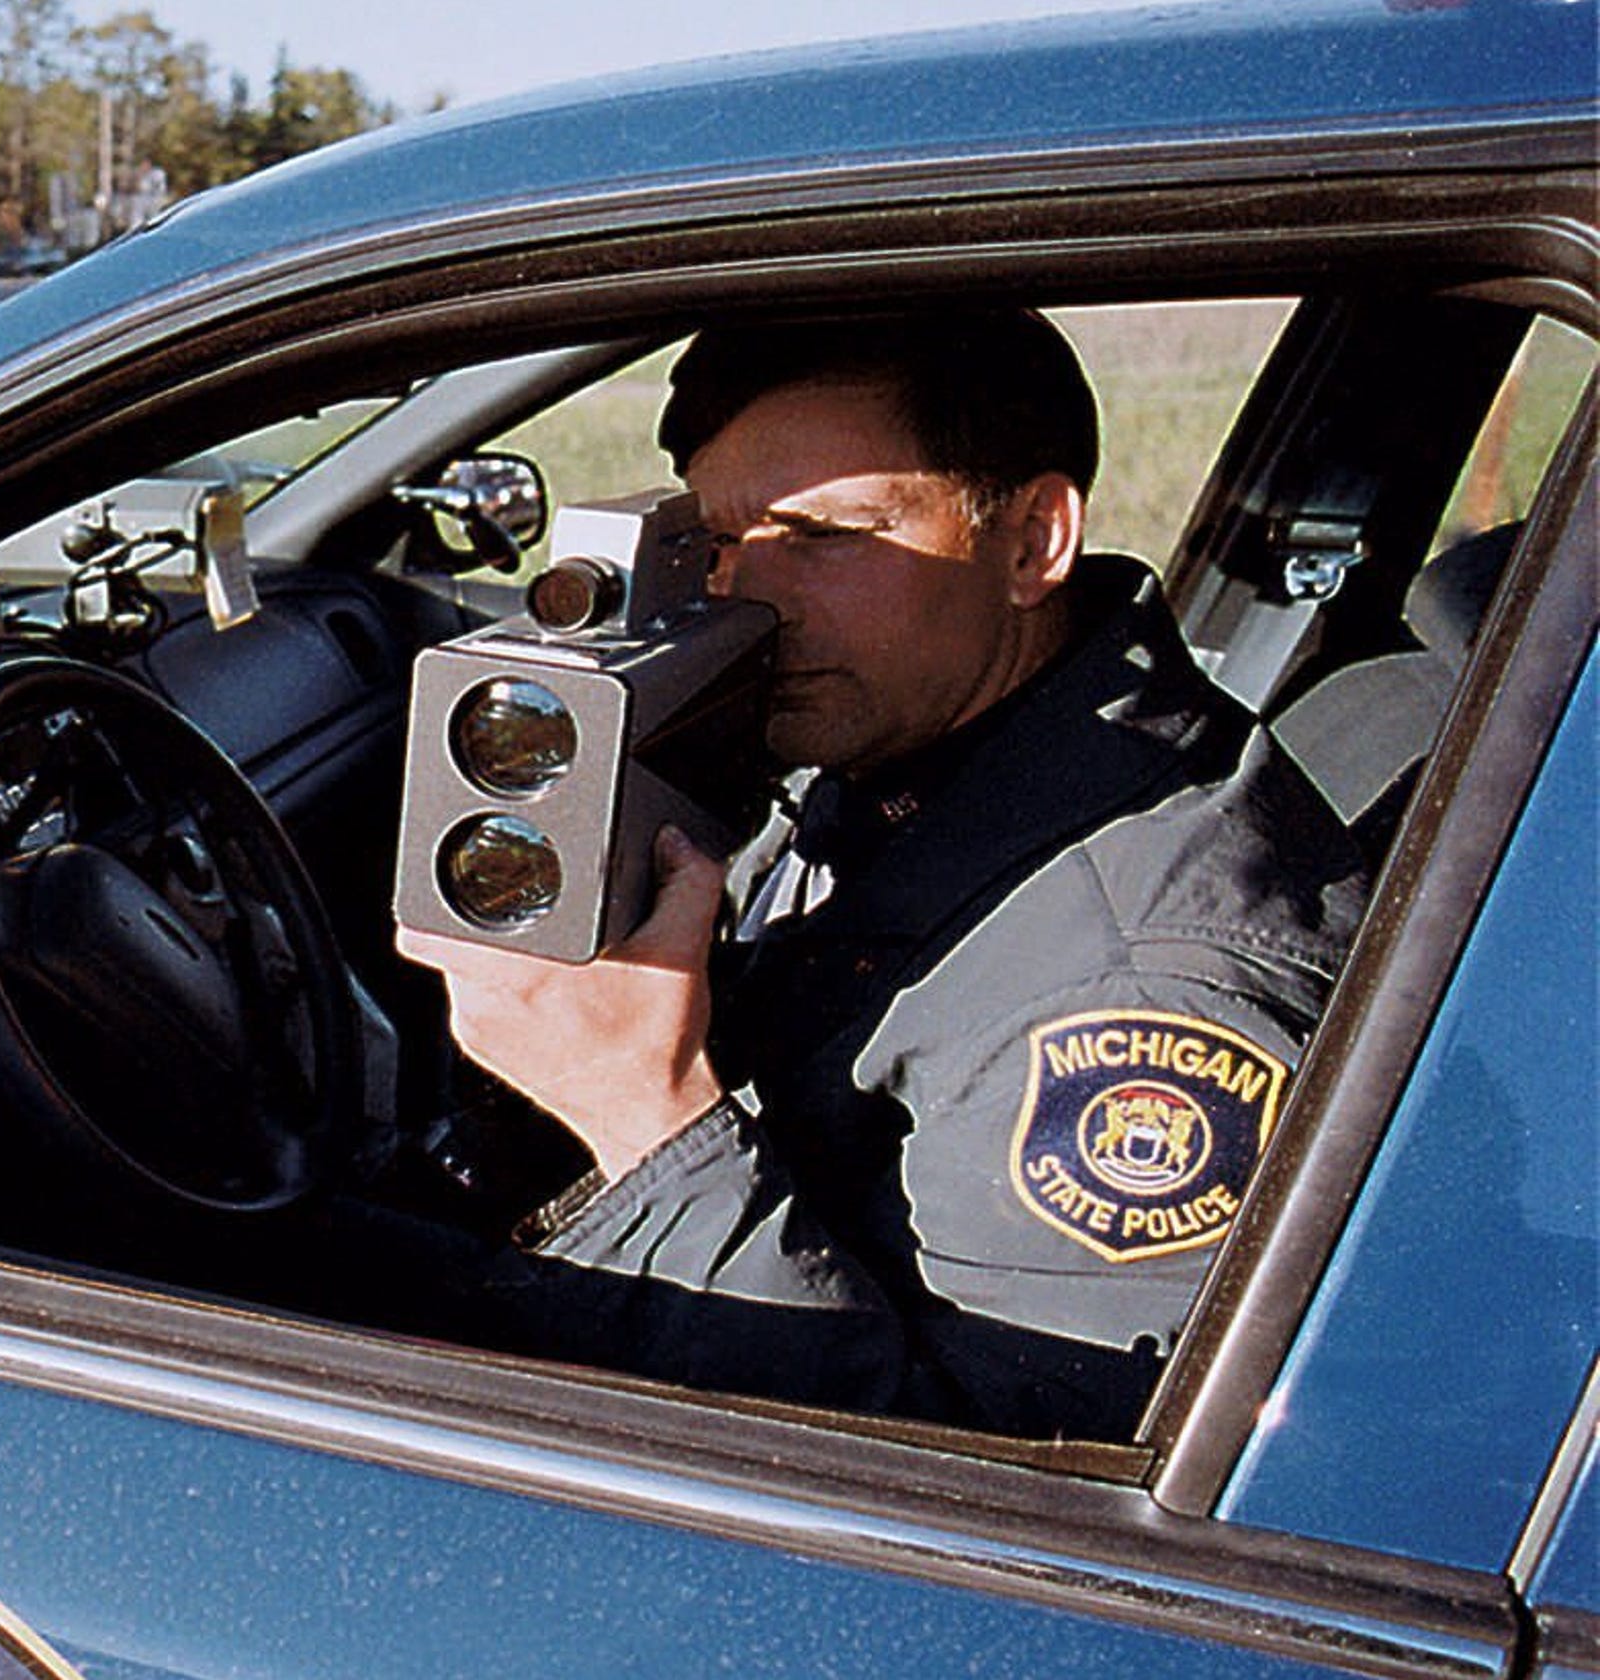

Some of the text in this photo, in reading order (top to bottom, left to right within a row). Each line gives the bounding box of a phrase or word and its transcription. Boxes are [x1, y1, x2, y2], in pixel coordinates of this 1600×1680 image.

[1044, 1029, 1268, 1103] MICHIGAN
[1026, 1154, 1240, 1239] STATE POLICE
